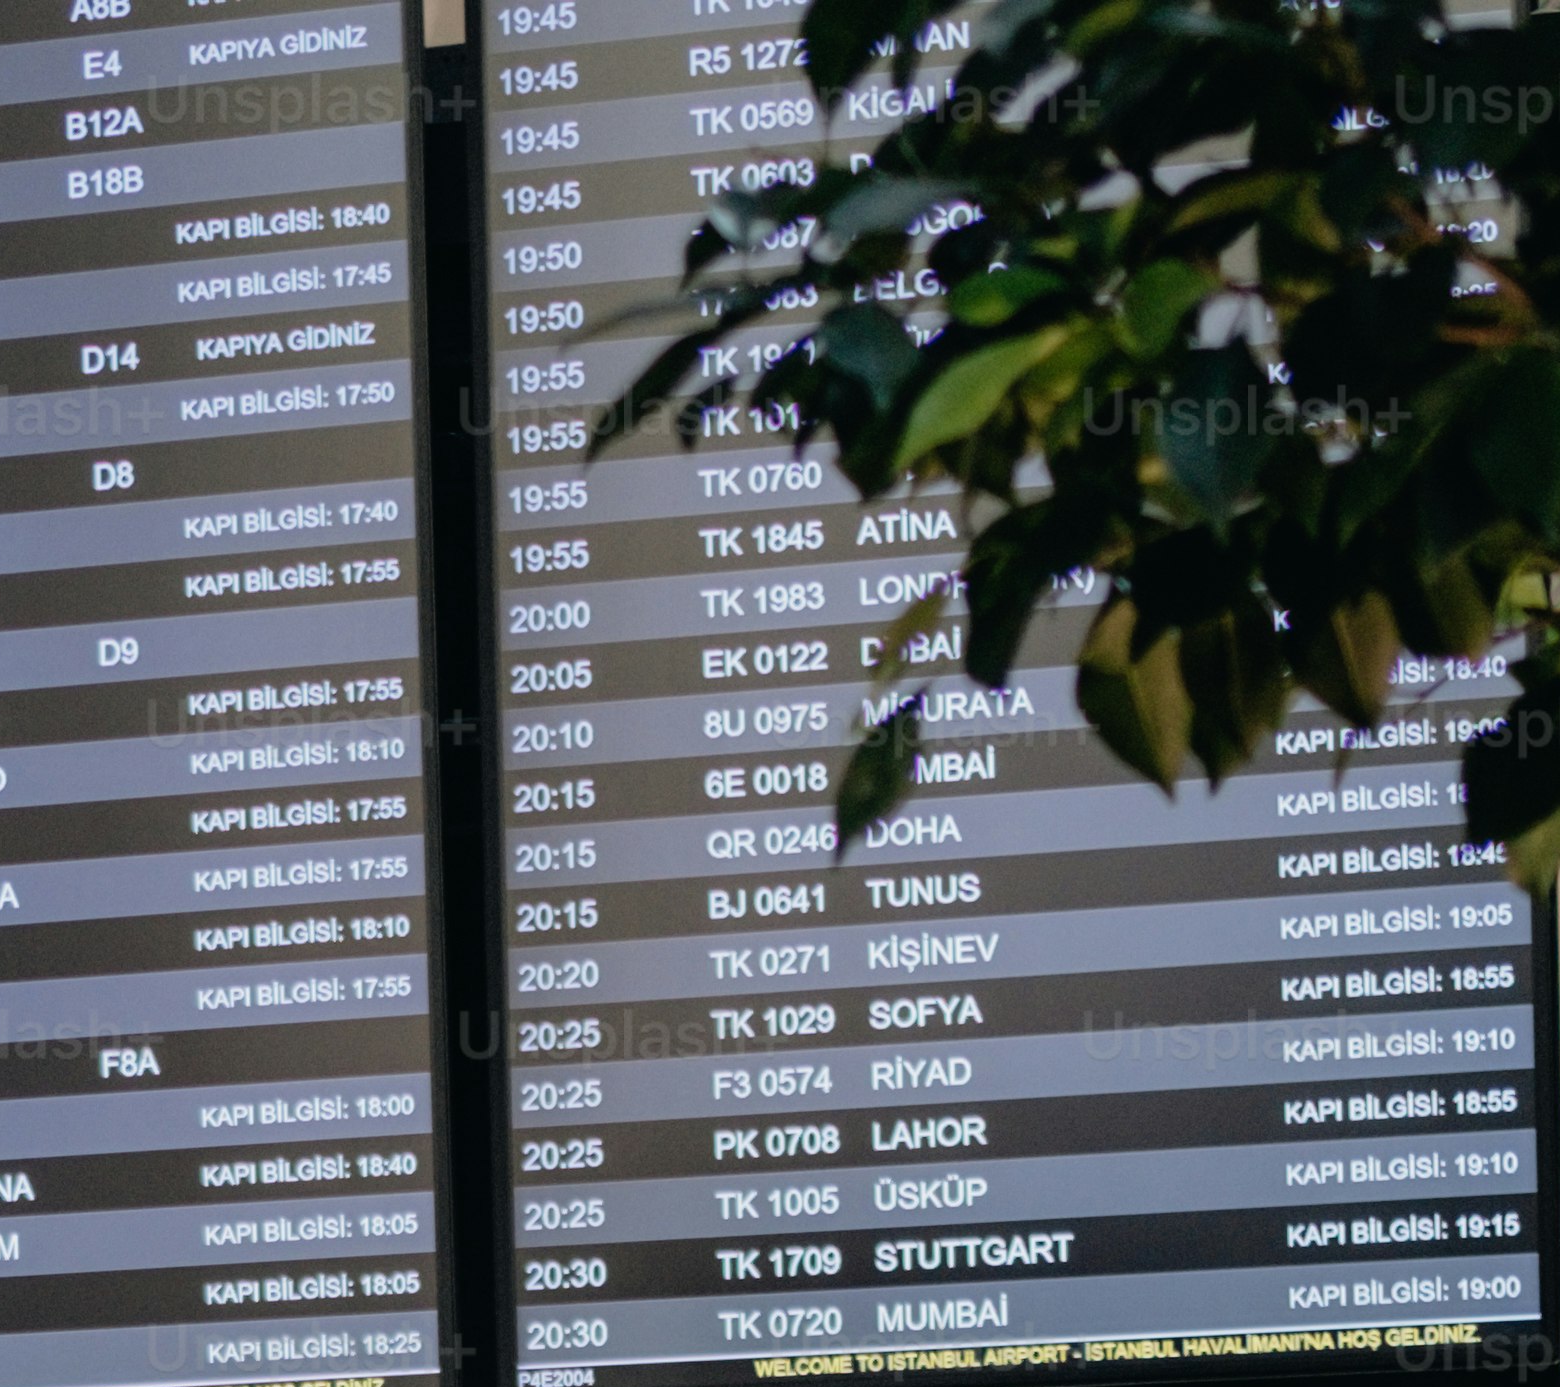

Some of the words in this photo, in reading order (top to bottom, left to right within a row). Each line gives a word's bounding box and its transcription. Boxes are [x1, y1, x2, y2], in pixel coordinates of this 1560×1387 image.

[64, 106, 145, 141] B12A
[81, 342, 141, 375] D14
[196, 332, 284, 361] KAPIYA
[286, 320, 376, 352] GİDİNİZ
[510, 539, 590, 574] 19:55
[698, 526, 744, 558] TK
[751, 519, 825, 554] 1845
[856, 508, 957, 546] ATİNA
[521, 1078, 603, 1112] 20:25
[713, 1069, 752, 1100] F3
[758, 1065, 833, 1097] 0574
[871, 1055, 972, 1091] RİYAD
[1283, 1037, 1341, 1063] KAPI
[1347, 1028, 1444, 1059] BİLGİSİ:
[1451, 1027, 1516, 1053] 19:10
[201, 1161, 257, 1188] KAPI
[260, 1153, 351, 1184] BİLGİSİ:
[357, 1151, 418, 1178] 18:40
[525, 1257, 607, 1291] 20:30
[715, 1249, 761, 1281] TK
[768, 1244, 842, 1278] 1709
[874, 1231, 1075, 1273] STUTTGART
[1286, 1221, 1346, 1248] KAPI
[1351, 1213, 1449, 1245] BİLGİSİ:
[1455, 1212, 1521, 1239] 19:15
